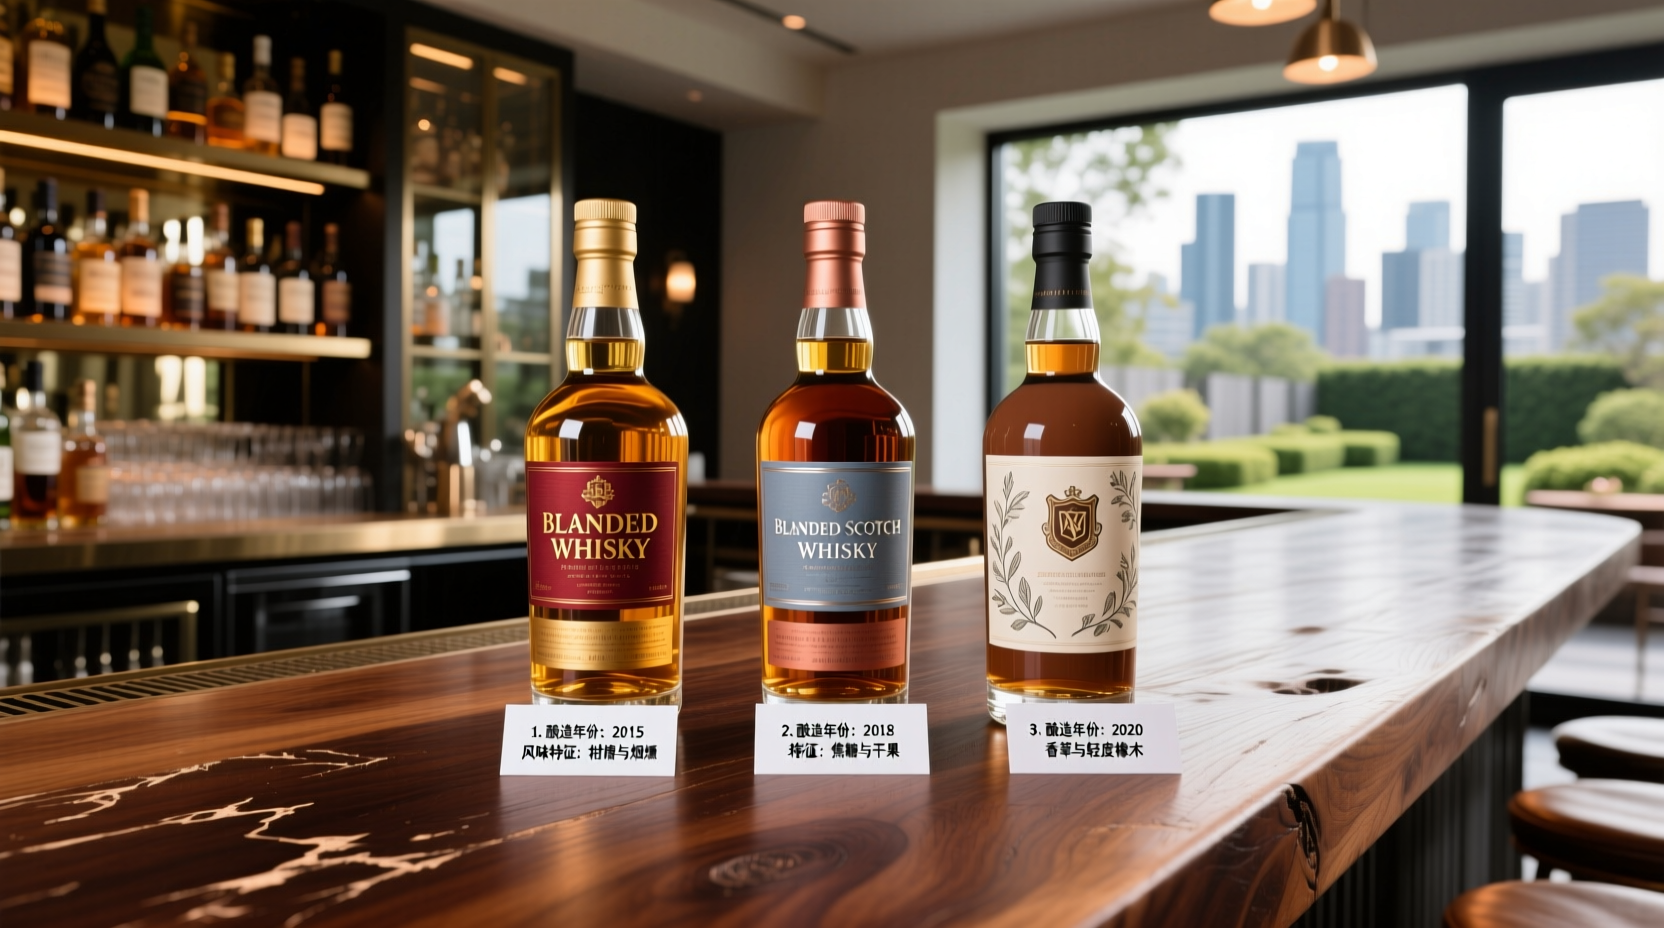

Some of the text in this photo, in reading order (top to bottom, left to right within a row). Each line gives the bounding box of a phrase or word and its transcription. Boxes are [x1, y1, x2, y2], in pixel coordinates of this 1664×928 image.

[542, 512, 658, 534] BLANDED
[774, 518, 901, 536] BLANDED SCOTCH
[550, 537, 651, 560] WHISKY
[797, 541, 878, 560] WHISKY
